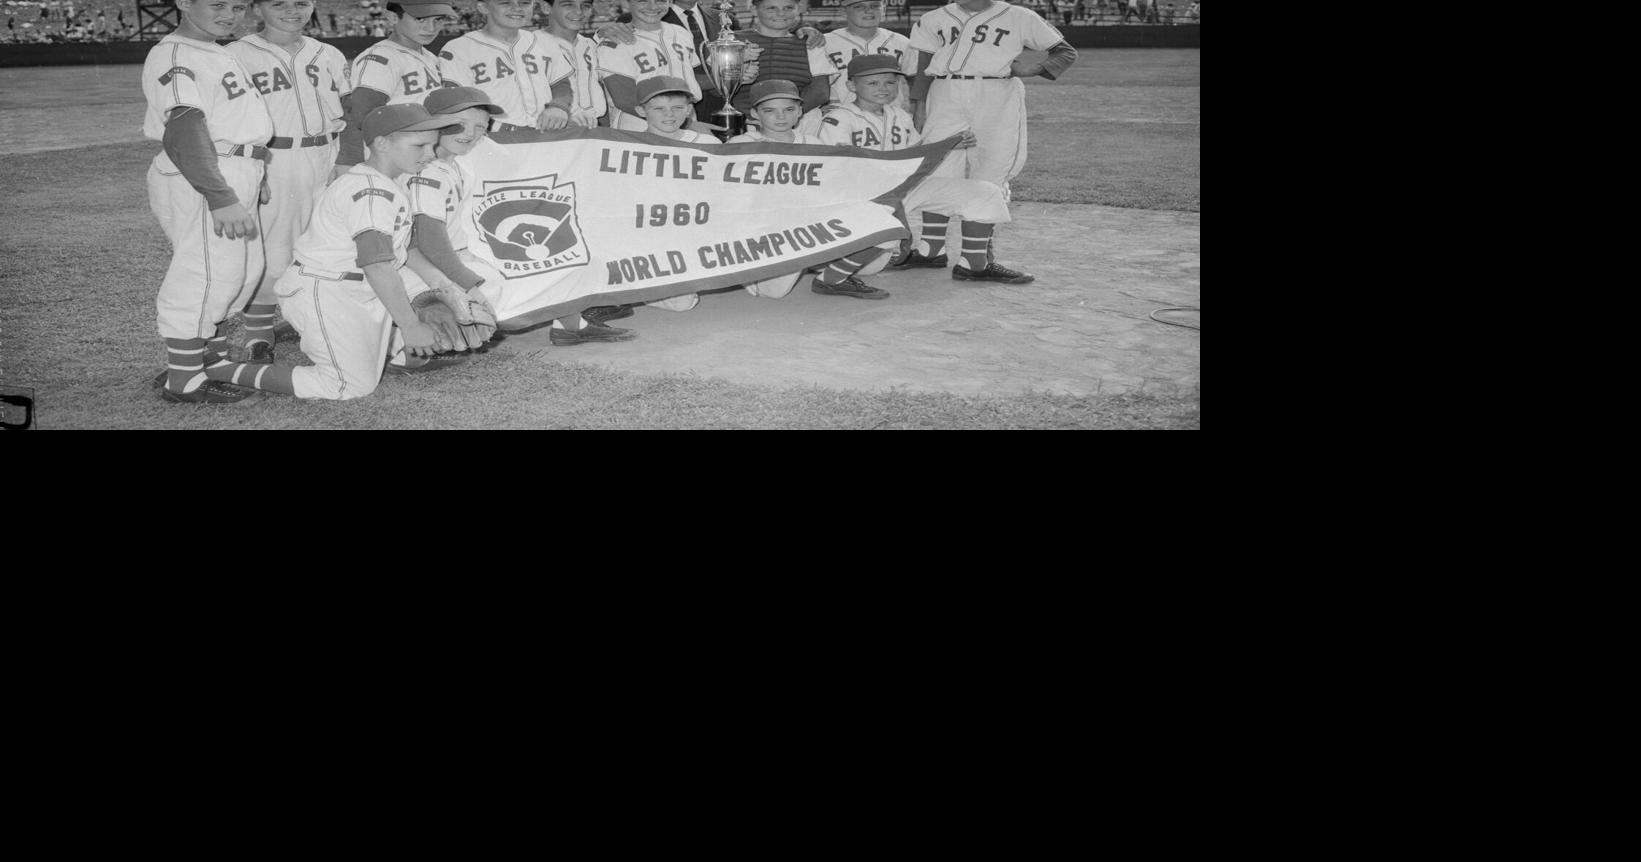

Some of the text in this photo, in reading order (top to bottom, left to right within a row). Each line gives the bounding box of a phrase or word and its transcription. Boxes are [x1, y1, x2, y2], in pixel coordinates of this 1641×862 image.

[470, 52, 552, 85] EAST
[600, 148, 824, 186] LITTLE LEAGUE
[474, 193, 507, 216] LITTLE
[519, 190, 572, 203] LEAGUE
[635, 202, 710, 228] 1960
[504, 251, 581, 271] BASEBALL
[606, 218, 852, 285] WORLD CHAMPIONS
